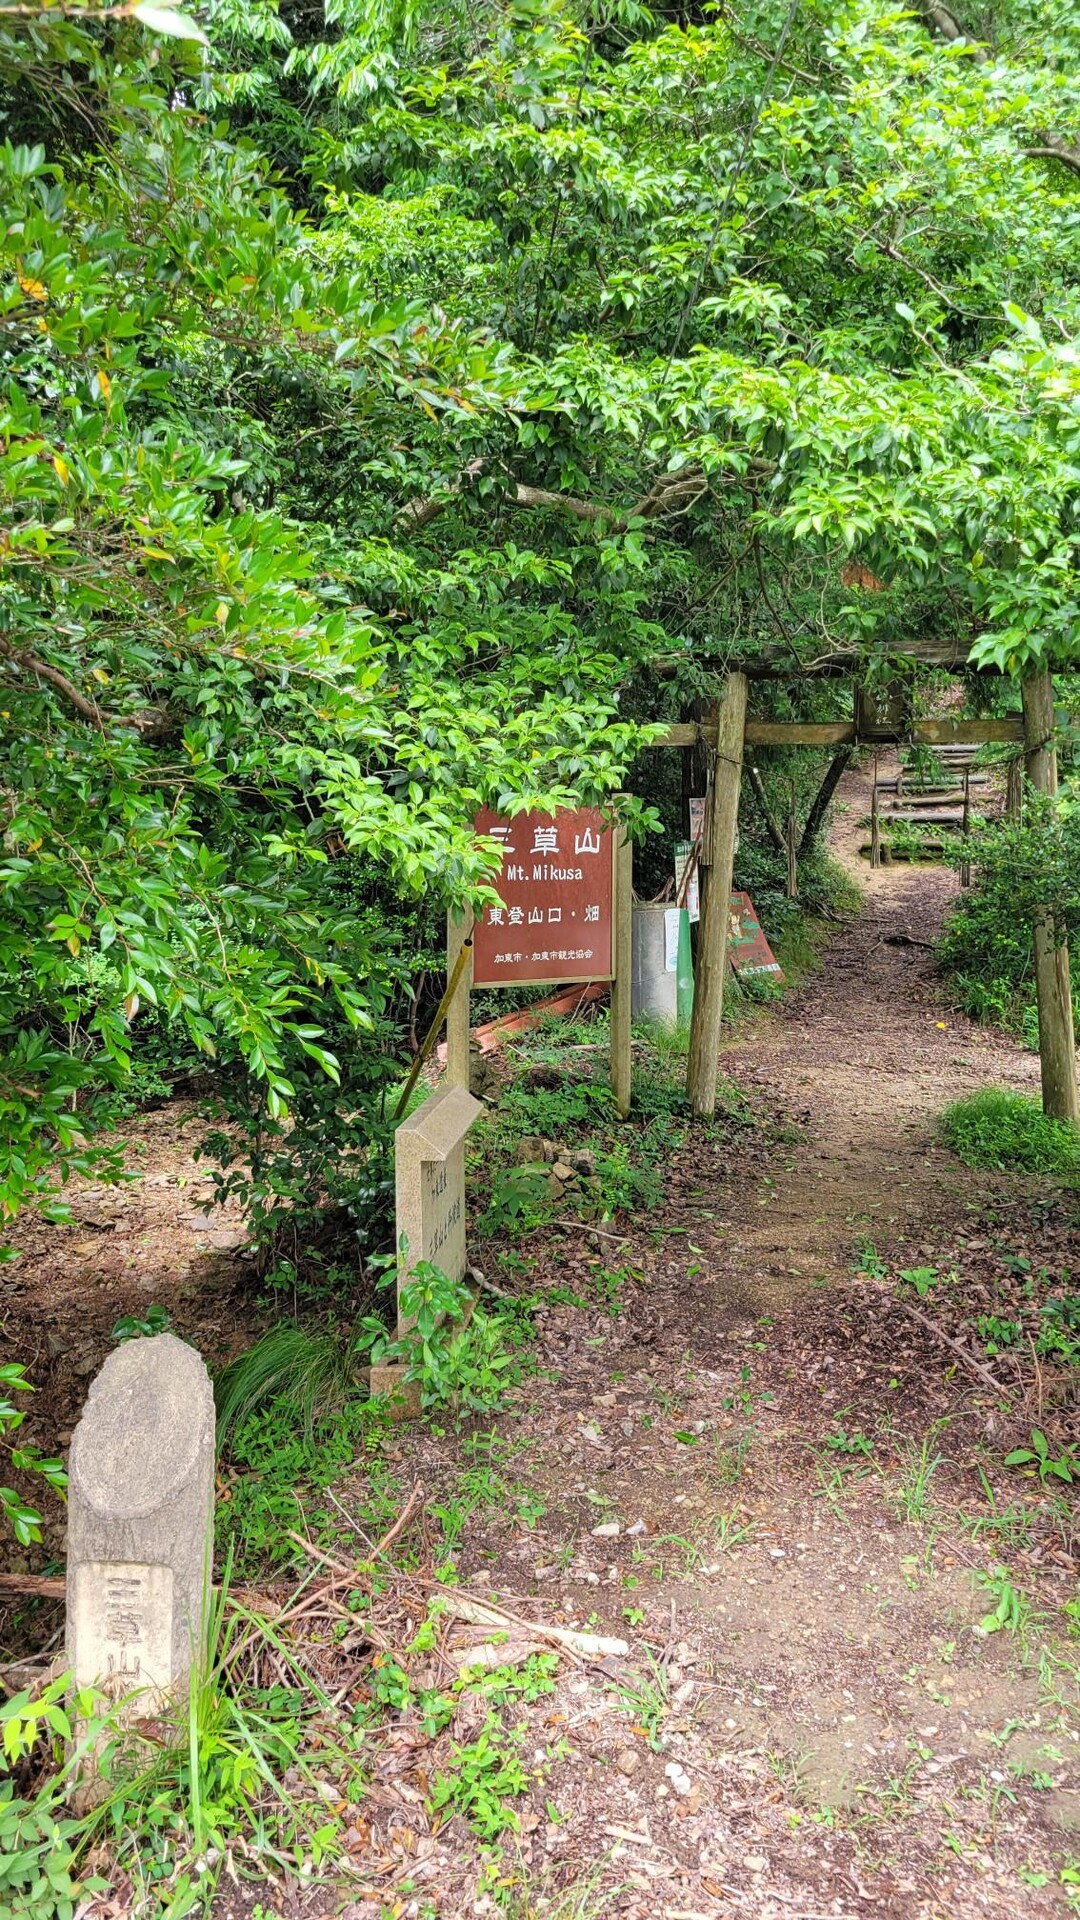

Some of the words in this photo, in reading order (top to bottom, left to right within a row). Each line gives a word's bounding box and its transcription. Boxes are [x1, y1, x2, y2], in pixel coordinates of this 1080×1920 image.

[489, 825, 600, 857] 三草山
[487, 904, 600, 926] 東登山口・畑
